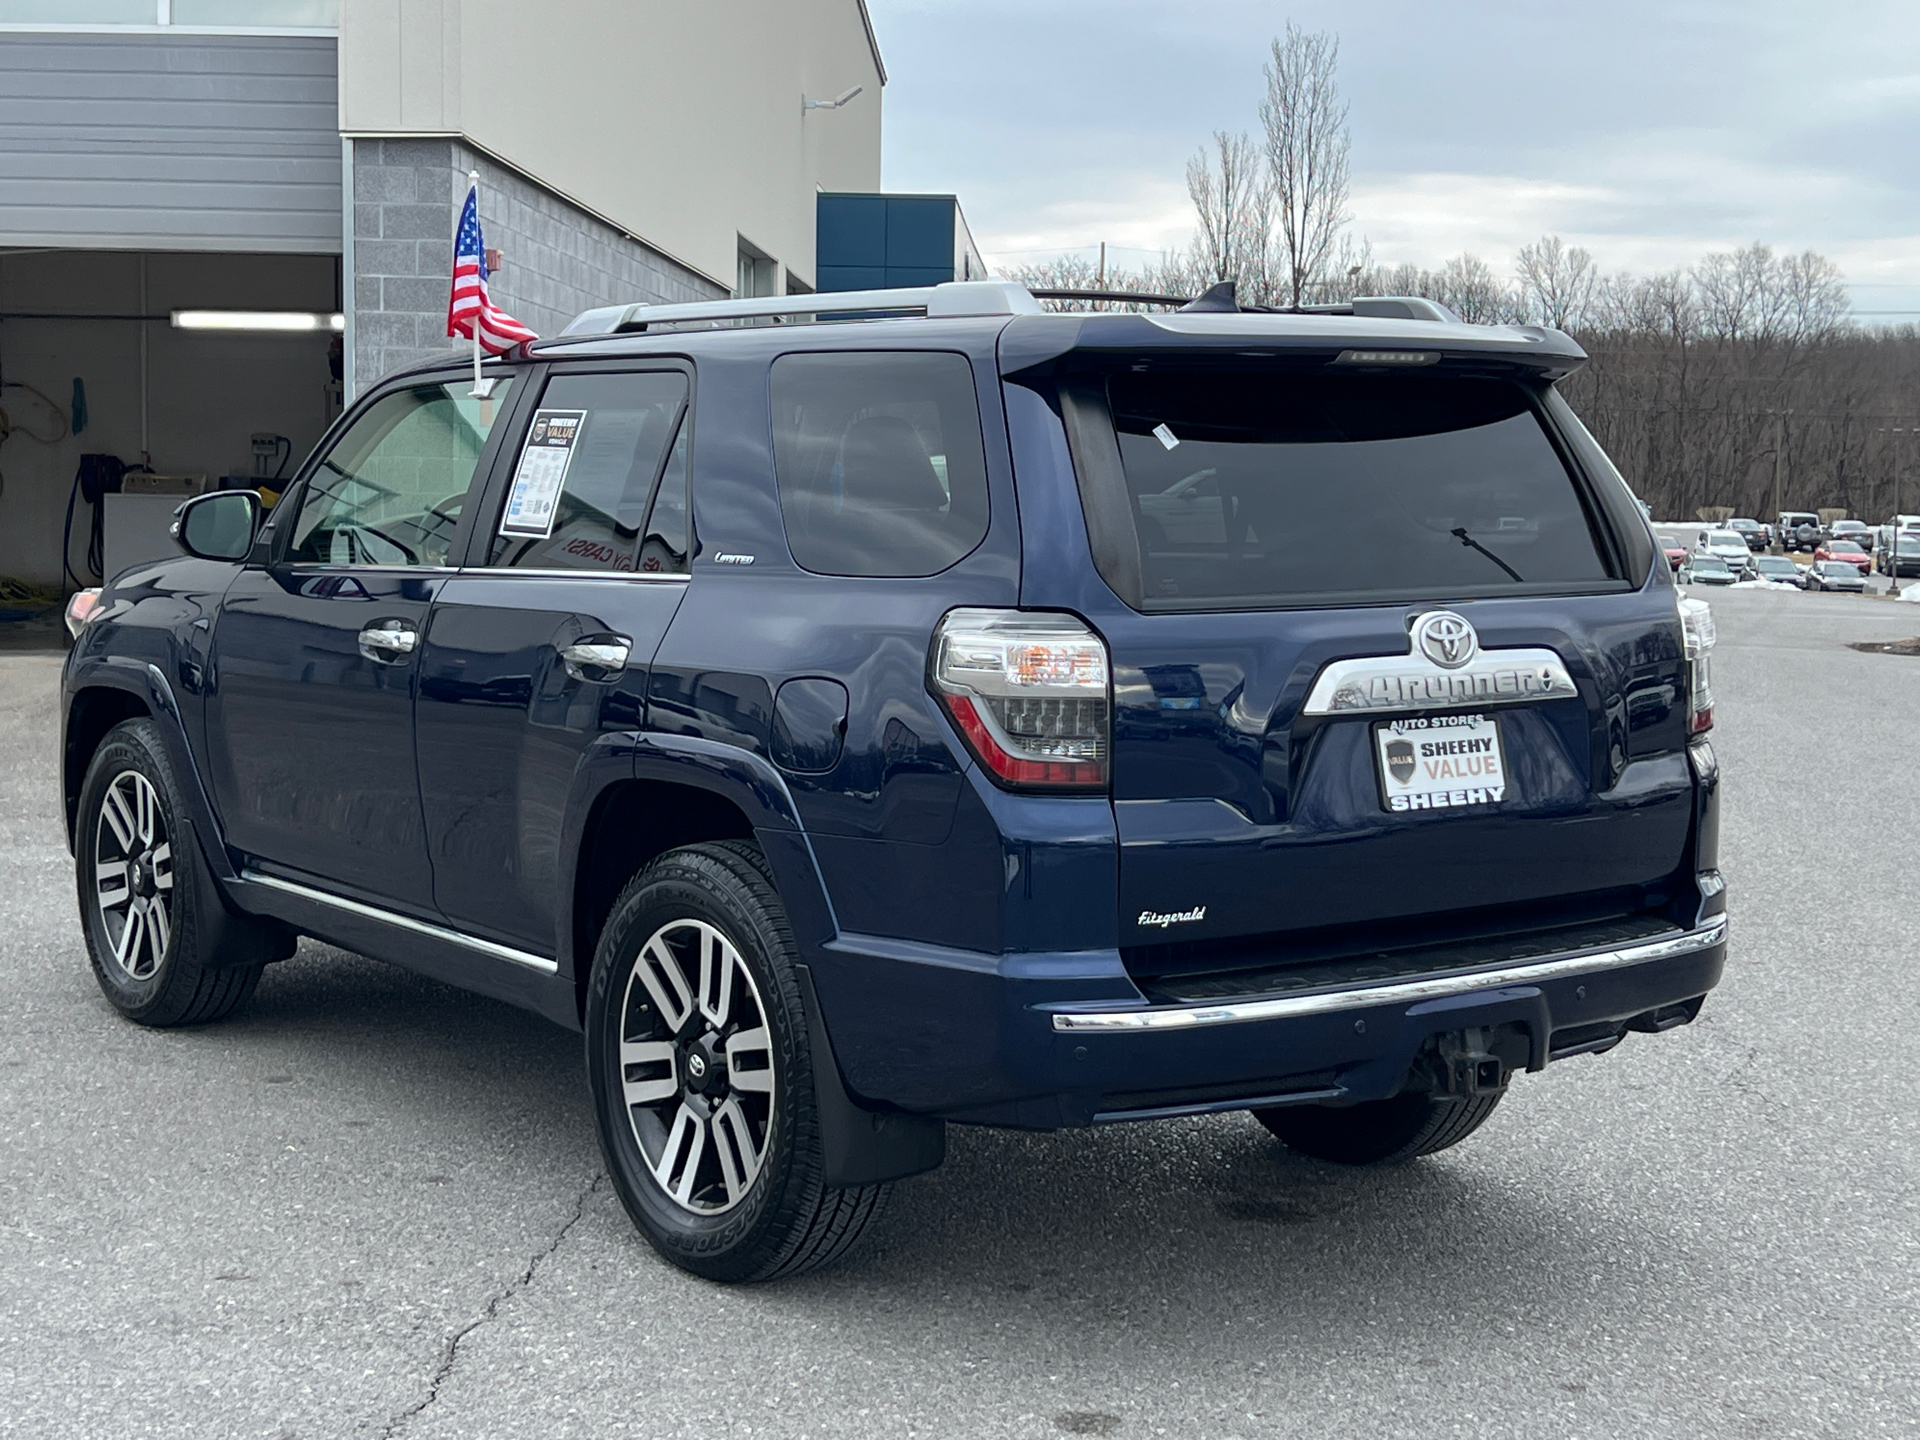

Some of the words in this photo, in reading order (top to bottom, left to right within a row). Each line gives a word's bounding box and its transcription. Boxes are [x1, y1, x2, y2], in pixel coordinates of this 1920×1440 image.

[547, 426, 576, 439] VALUE
[1389, 717, 1428, 732] AUTO
[1431, 714, 1485, 728] STORES
[1420, 737, 1493, 758] SHEEHY
[1387, 755, 1414, 766] VALUE
[1423, 755, 1498, 780] VALUE
[1390, 786, 1506, 812] SHEEHY
[1138, 905, 1206, 928] Fitzgerald
